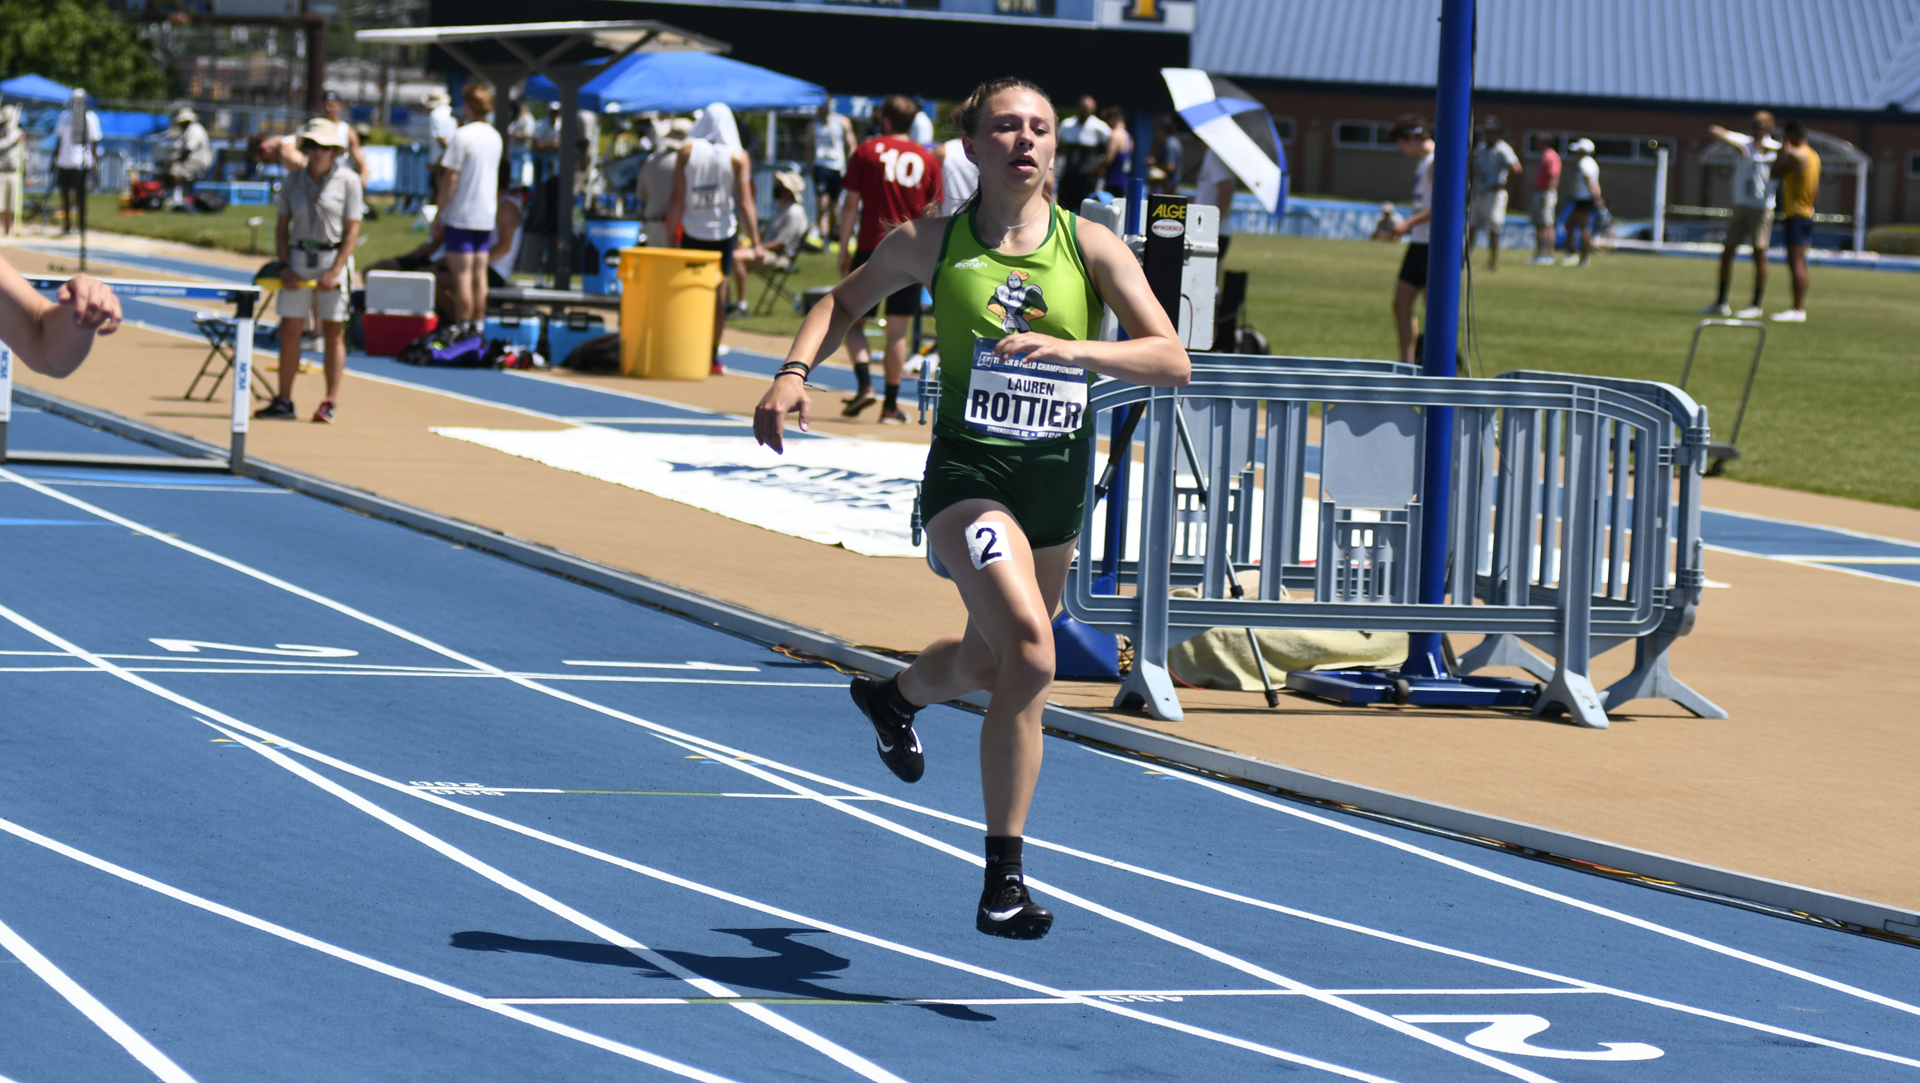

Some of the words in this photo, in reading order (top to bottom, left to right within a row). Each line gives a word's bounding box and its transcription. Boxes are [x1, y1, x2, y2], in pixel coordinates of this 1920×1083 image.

[879, 148, 925, 188] 10
[1152, 203, 1187, 219] ALGE
[993, 356, 1014, 366] TCK
[1037, 363, 1084, 376] CHAMPIONSHIPS
[1007, 377, 1055, 396] LAUREN
[970, 388, 1082, 429] ROTTIER
[975, 527, 1002, 564] 2
[1391, 1014, 1665, 1061] 2
